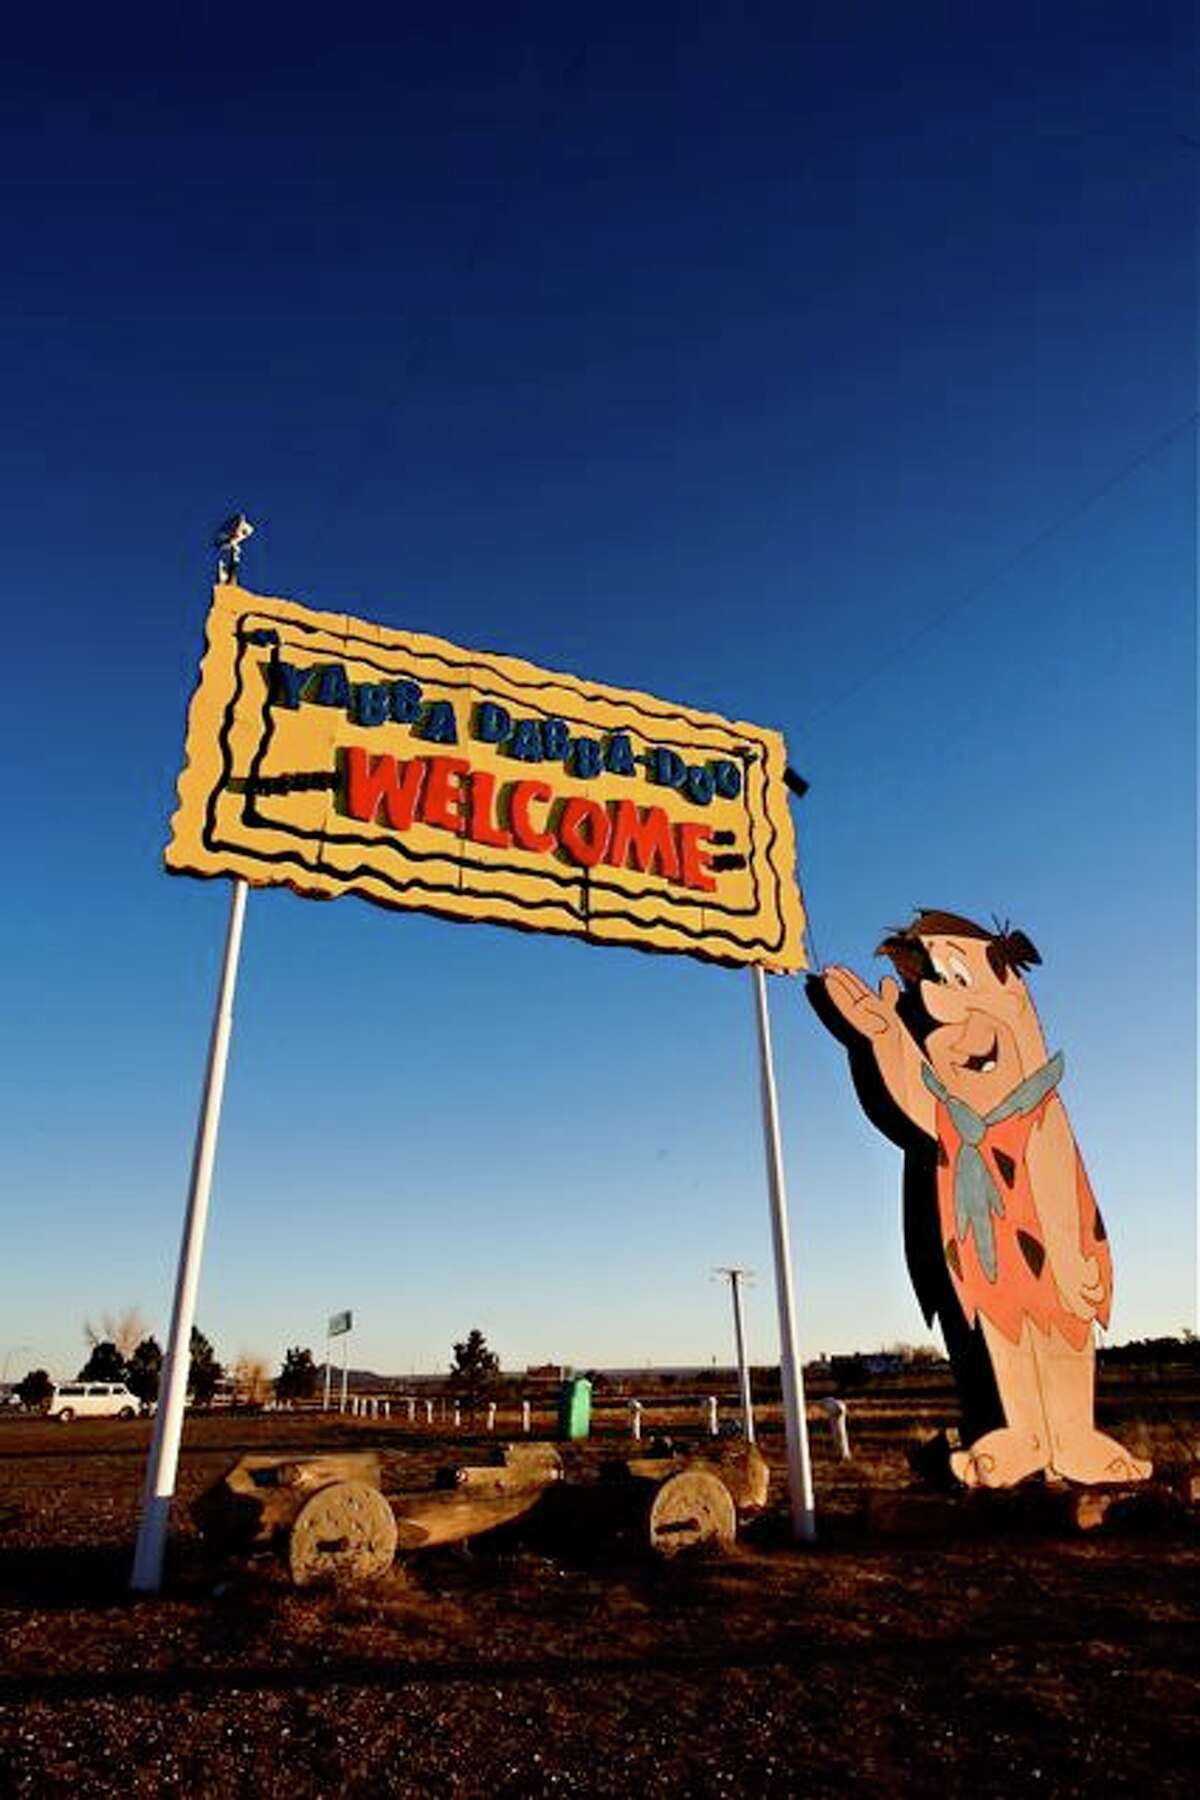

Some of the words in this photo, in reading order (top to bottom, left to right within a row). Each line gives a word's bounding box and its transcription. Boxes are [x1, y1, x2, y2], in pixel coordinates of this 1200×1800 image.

[266, 662, 458, 745] YABBA
[472, 701, 742, 805] DABBA-DOO
[339, 746, 717, 892] WELCOME
